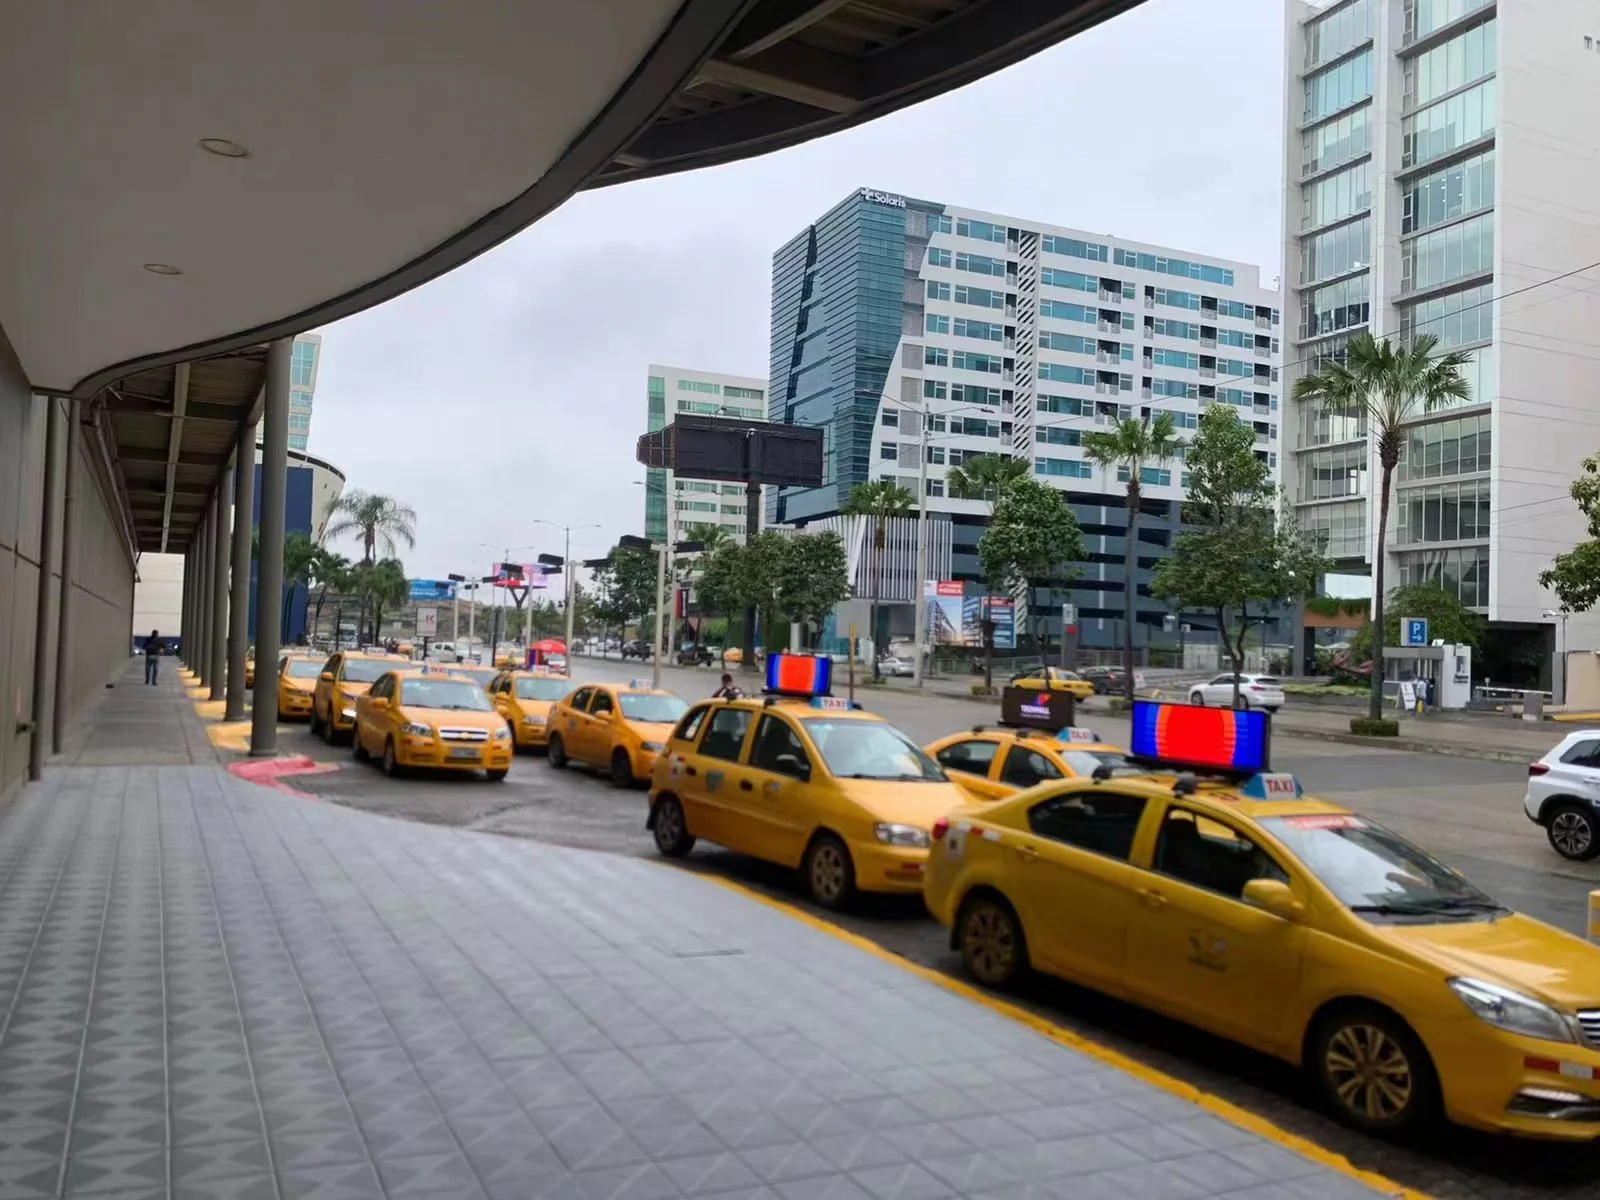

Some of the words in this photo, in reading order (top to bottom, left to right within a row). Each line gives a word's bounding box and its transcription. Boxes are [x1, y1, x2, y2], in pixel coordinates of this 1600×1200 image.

[874, 191, 906, 208] Solaris
[1413, 622, 1421, 635] P
[1071, 731, 1089, 739] TAXI
[1265, 779, 1294, 793] TAXI
